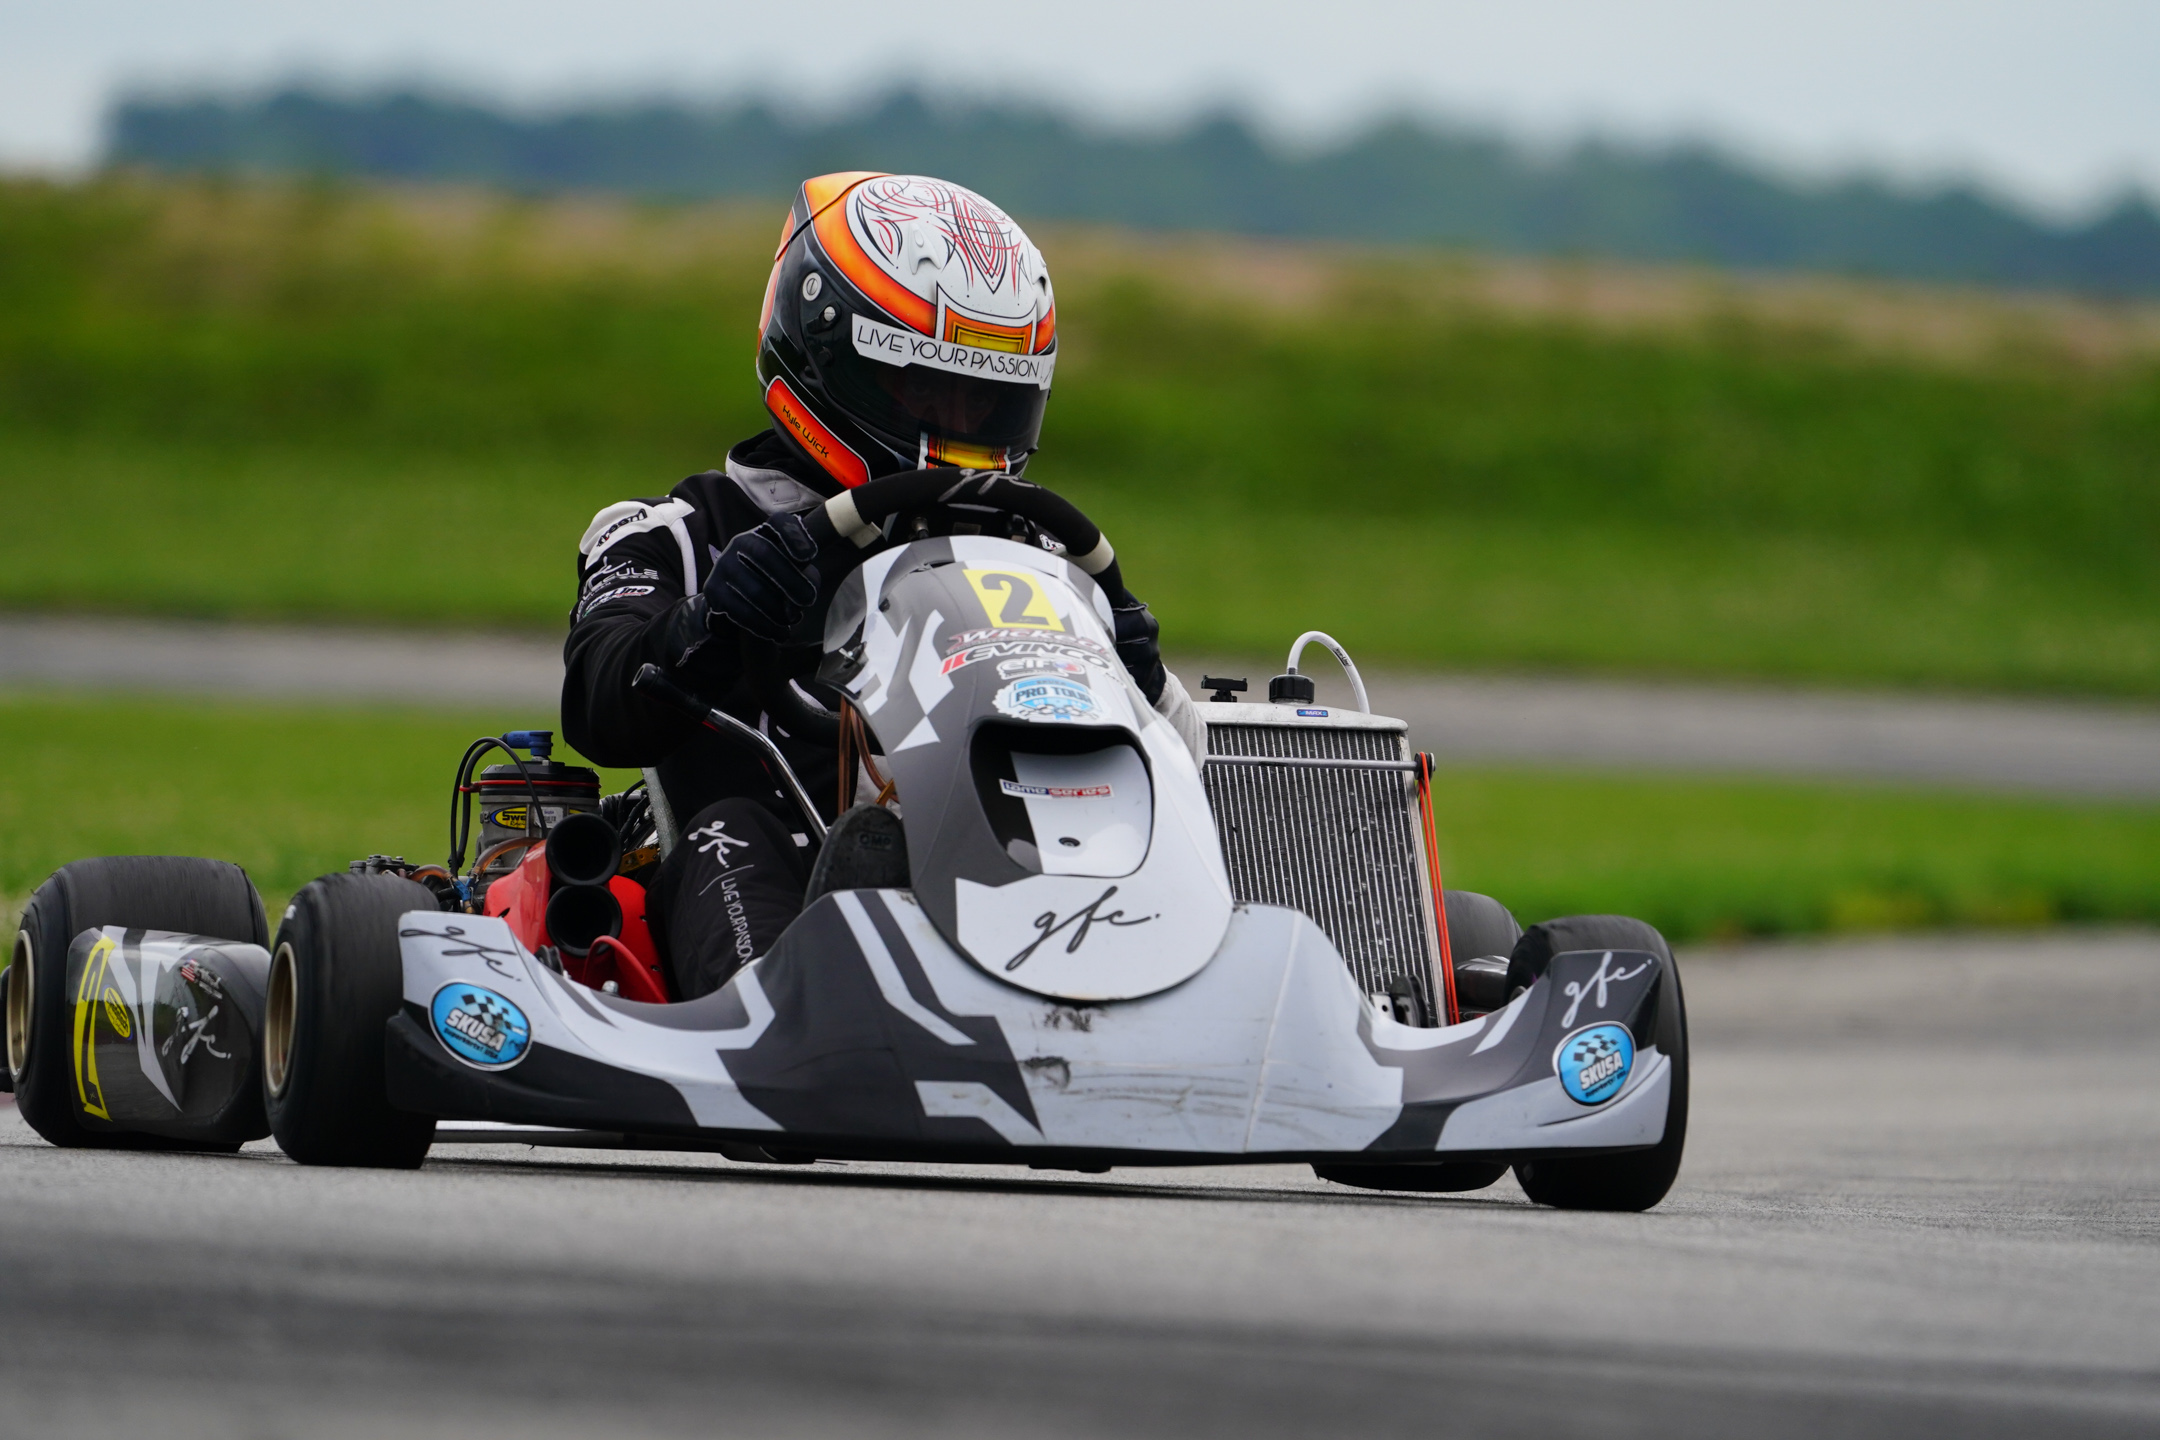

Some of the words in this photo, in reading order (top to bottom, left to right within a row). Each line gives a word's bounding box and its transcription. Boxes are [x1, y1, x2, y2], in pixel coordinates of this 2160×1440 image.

[856, 324, 904, 354] LIVE
[908, 337, 969, 368] YOUR
[969, 352, 1040, 379] PASSION
[781, 404, 802, 433] Kyle
[802, 427, 830, 459] Wick
[980, 573, 1050, 626] 2
[963, 640, 1112, 670] EVINCO
[1015, 686, 1047, 702] PRO
[720, 877, 740, 902] LIVE
[726, 899, 747, 927] YOUR
[445, 1007, 507, 1053] SKUSA
[1579, 1049, 1624, 1091] SKUSA
